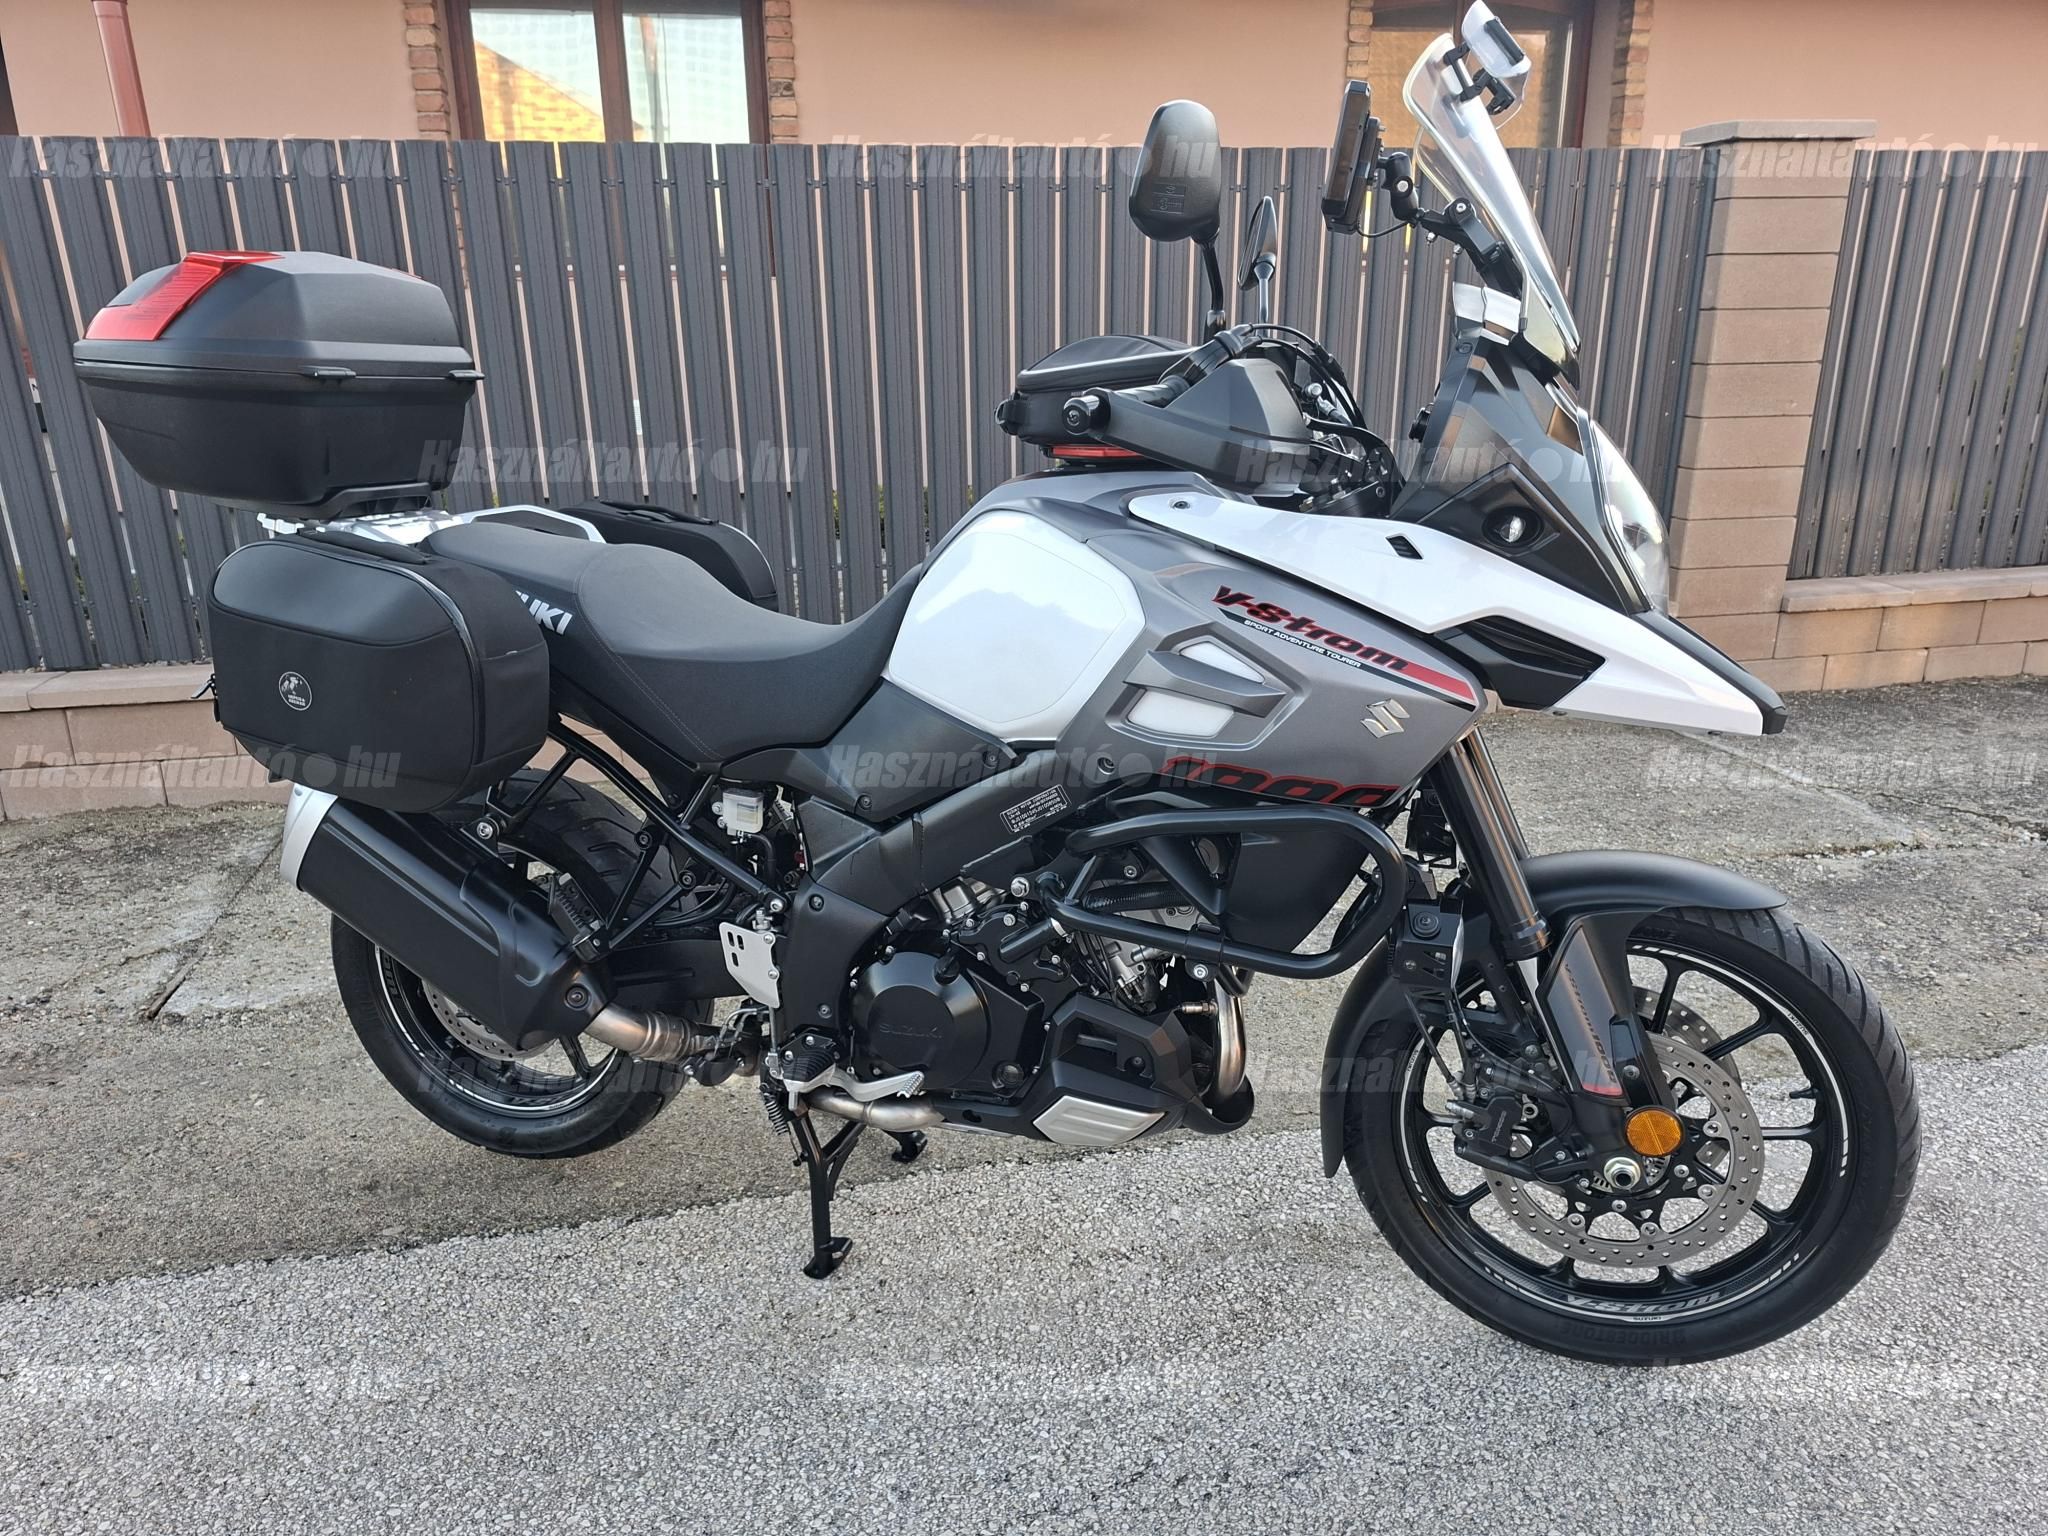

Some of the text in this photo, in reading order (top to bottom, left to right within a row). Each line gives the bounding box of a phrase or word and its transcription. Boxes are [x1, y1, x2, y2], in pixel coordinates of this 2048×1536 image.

[1211, 585, 1409, 671] V-Strom
[1244, 619, 1362, 668] SPORT ADVENTURE TOURER
[1567, 1292, 1722, 1314] V-Strom
